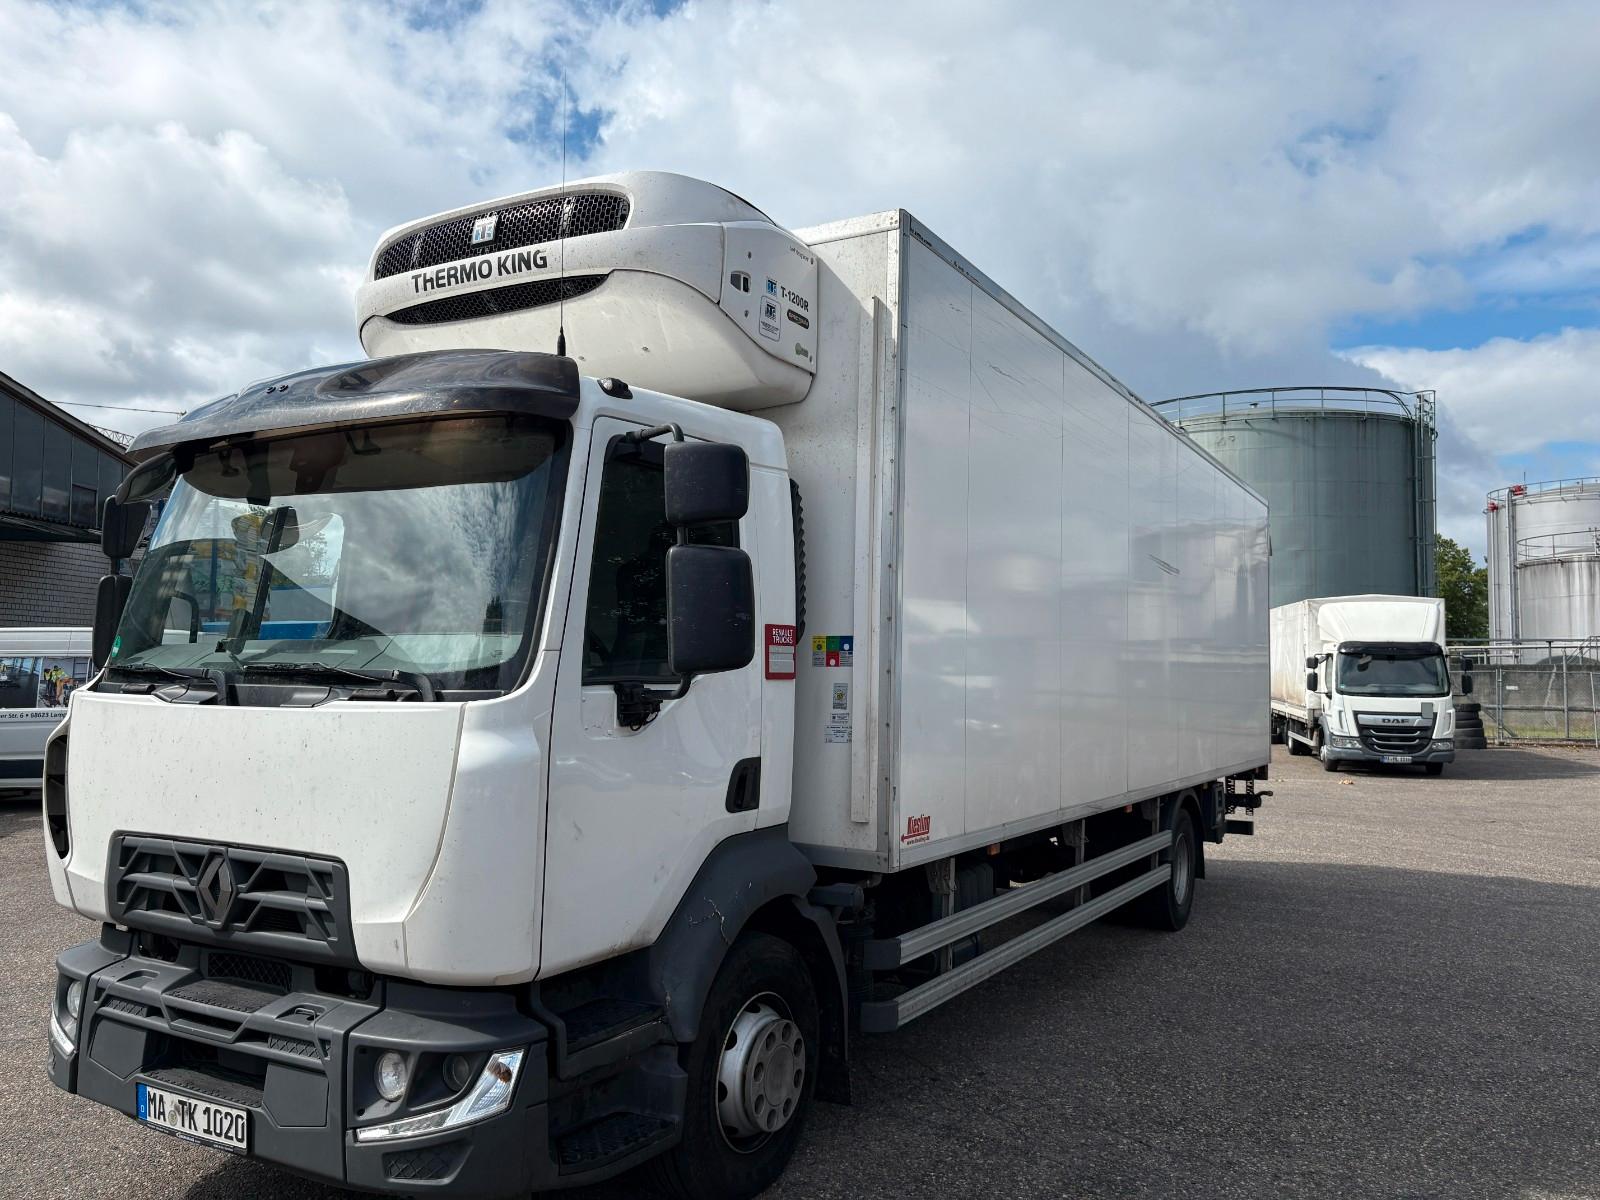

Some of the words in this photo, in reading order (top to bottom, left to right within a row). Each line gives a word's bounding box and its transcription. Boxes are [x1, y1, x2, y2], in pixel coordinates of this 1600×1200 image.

[497, 249, 548, 276] KING
[780, 286, 809, 313] T-1200R
[772, 628, 794, 637] RENAULT
[772, 636, 794, 644] TRUCKS
[907, 813, 931, 835] Kiesling
[147, 1090, 167, 1122] MA
[177, 1099, 198, 1132] TK
[203, 1106, 246, 1144] 1020
